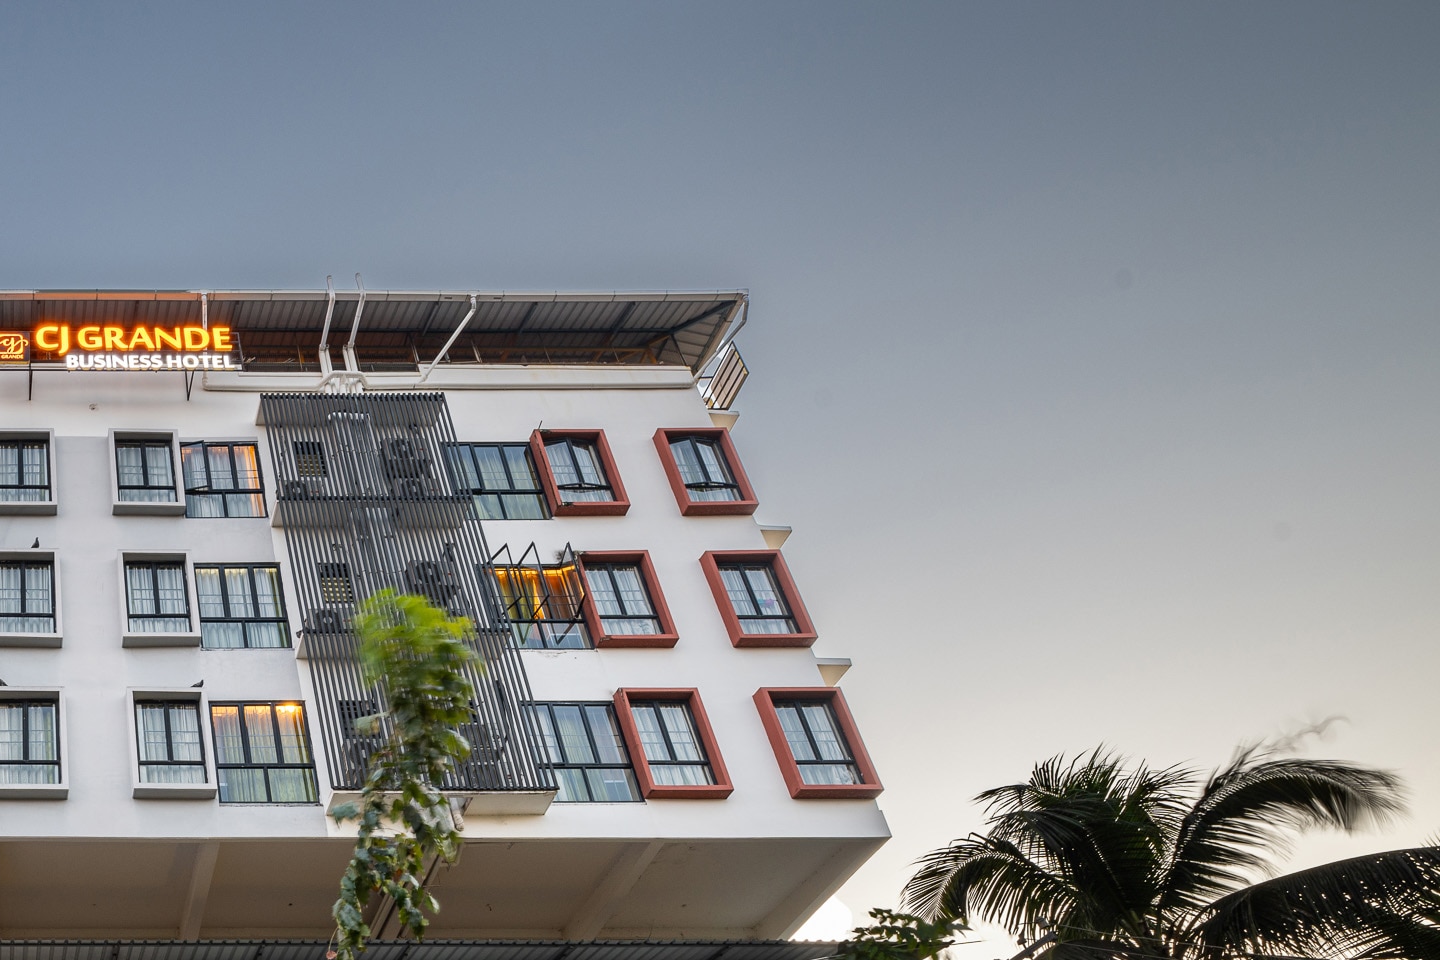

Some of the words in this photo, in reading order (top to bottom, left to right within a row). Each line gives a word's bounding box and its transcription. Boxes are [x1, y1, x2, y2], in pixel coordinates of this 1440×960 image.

[35, 325, 69, 354] CJ
[77, 327, 233, 351] GRANDE
[66, 354, 162, 368] BUSINESS
[167, 355, 235, 369] HOTEL
